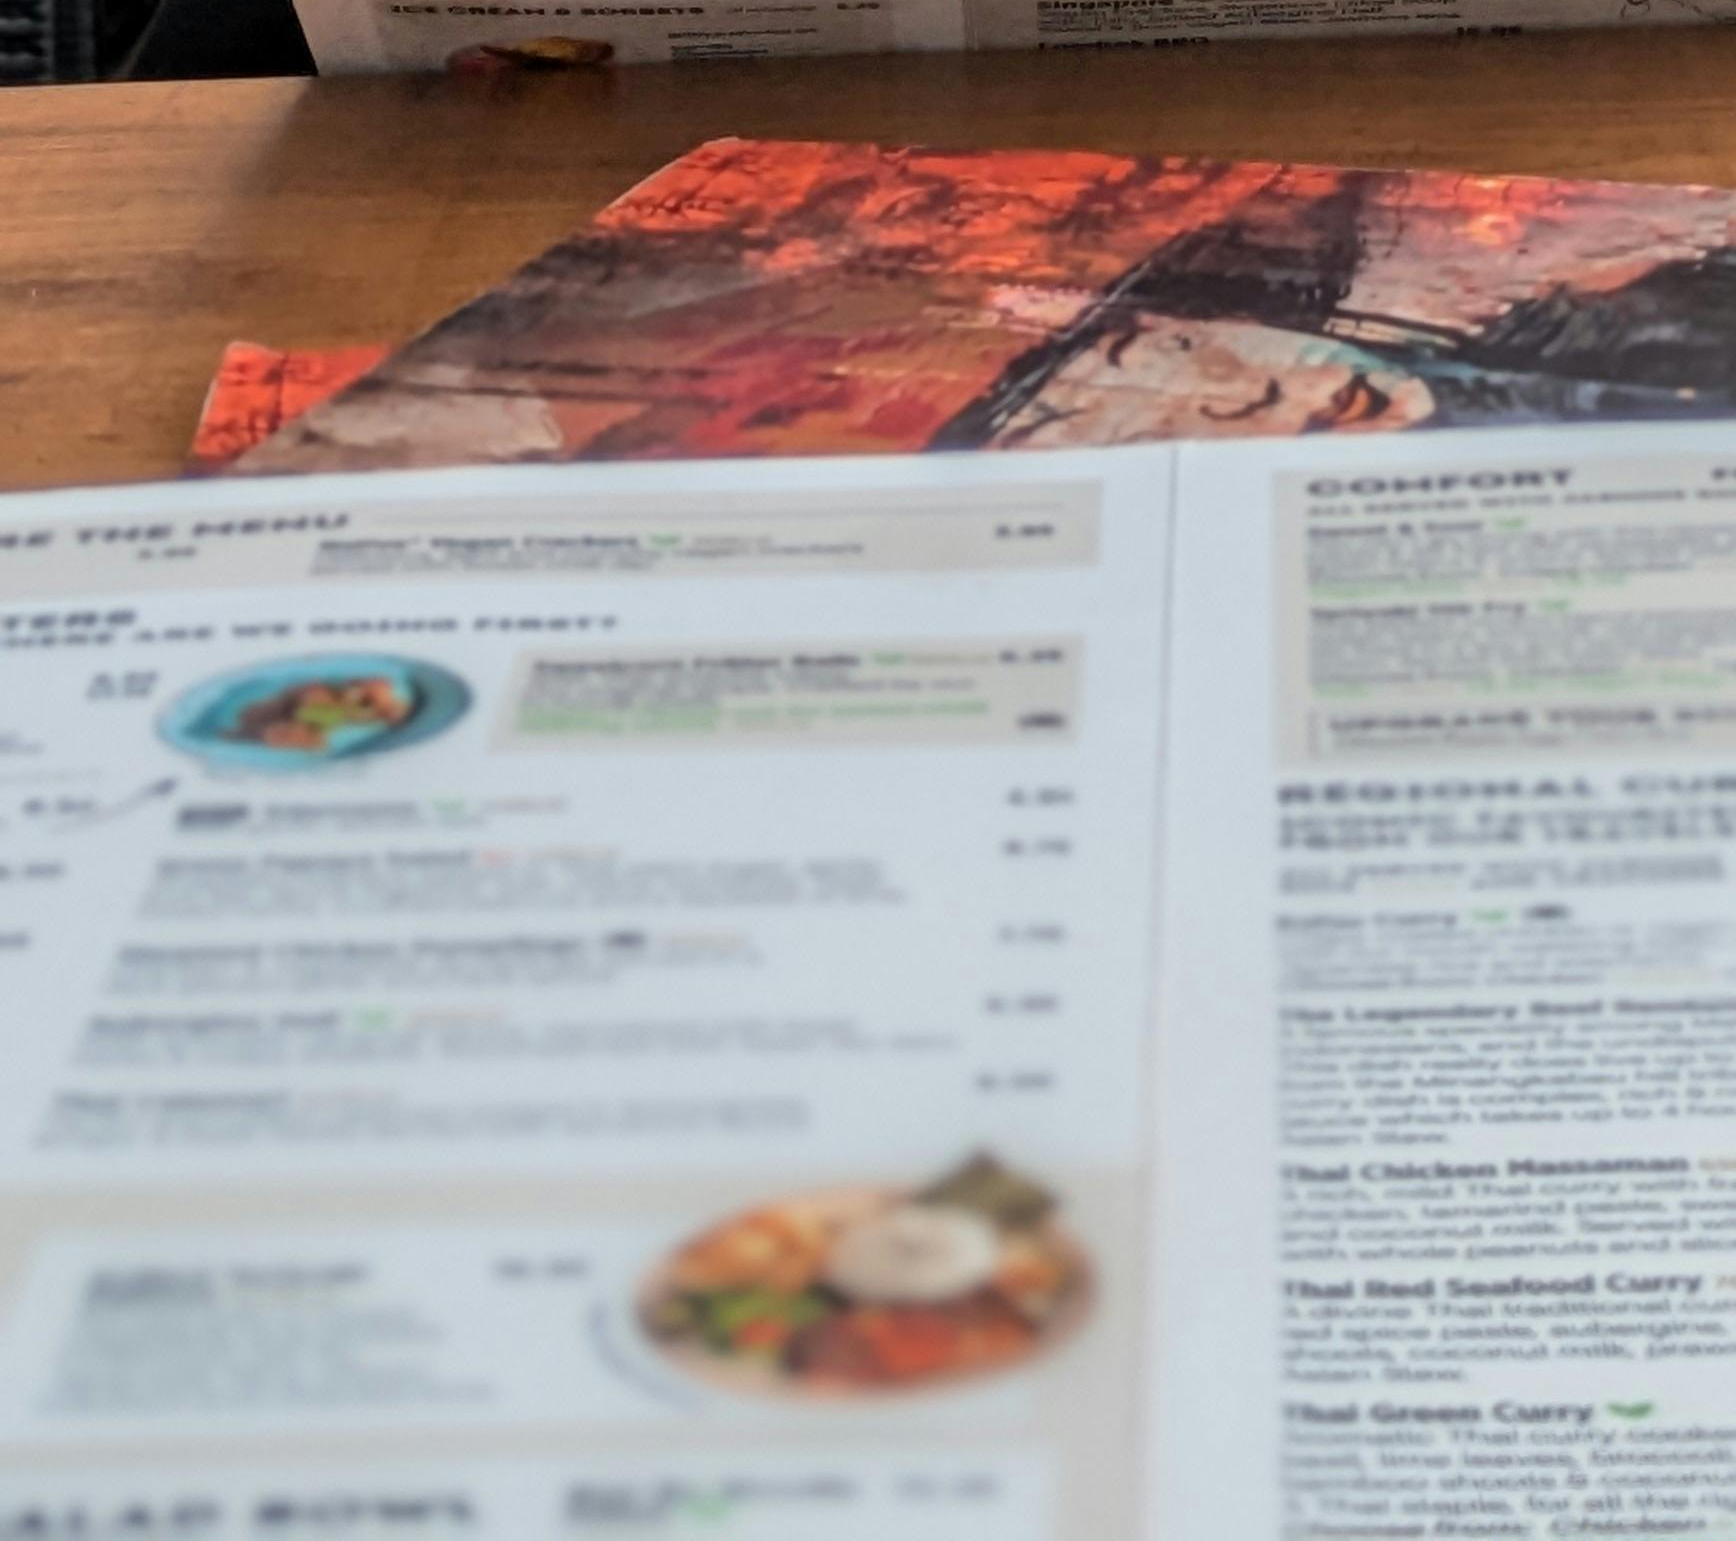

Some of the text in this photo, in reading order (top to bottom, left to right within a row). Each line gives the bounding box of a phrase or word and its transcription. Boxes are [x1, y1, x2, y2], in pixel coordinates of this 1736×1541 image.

[1306, 467, 1573, 498] COMFORT
[191, 511, 352, 537] MENU
[1276, 776, 1593, 805] REGIONAL
[1358, 1157, 1499, 1181] Chicken
[1506, 1155, 1690, 1178] Massaman
[1362, 1276, 1437, 1300] Red
[1444, 1272, 1597, 1298] Seafood
[1602, 1271, 1704, 1296] Curry
[1368, 1398, 1483, 1425] Green
[1491, 1397, 1596, 1427] Curry
